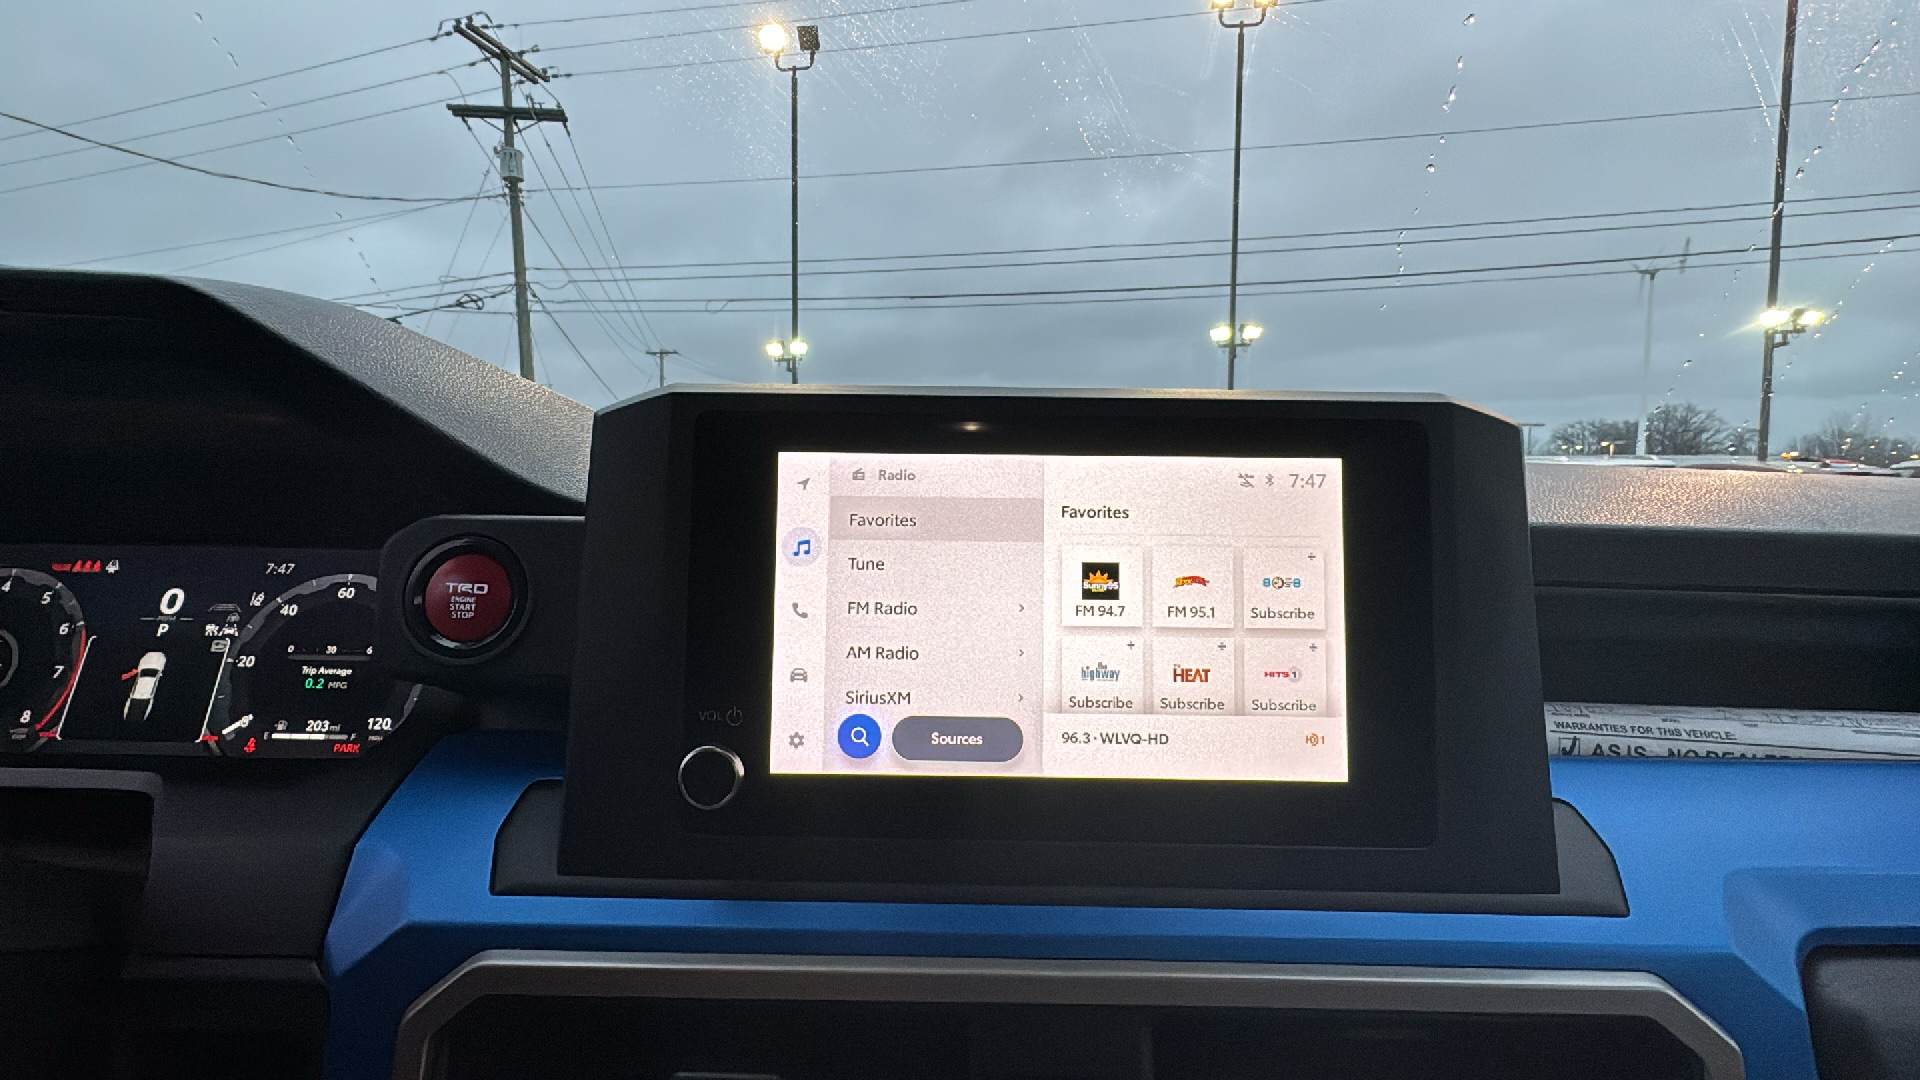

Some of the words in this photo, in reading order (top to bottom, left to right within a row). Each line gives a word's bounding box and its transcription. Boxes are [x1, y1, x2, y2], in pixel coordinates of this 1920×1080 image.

[878, 470, 916, 482] Radio
[1289, 474, 1326, 489] 7:47
[1061, 505, 1129, 520] Favorites
[849, 513, 917, 528] Favorites
[265, 562, 295, 575] 7:47
[848, 557, 885, 571] Tune
[338, 587, 355, 600] 60
[445, 582, 489, 595] TRD
[41, 592, 52, 604] 5
[159, 587, 185, 615] 0
[280, 603, 298, 617] 40
[449, 603, 477, 611] START
[848, 602, 870, 615] FM
[874, 601, 918, 616] Radio
[1075, 606, 1095, 617] FM
[1098, 605, 1126, 617] 94.7
[1167, 606, 1187, 618] FM
[1190, 606, 1216, 618] 95.1
[1250, 607, 1316, 620] Subscribe
[451, 611, 475, 619] STOP
[59, 623, 71, 635] 6
[156, 623, 170, 637] P
[846, 647, 871, 660] AM
[875, 646, 919, 661] Radio
[237, 655, 255, 667] 20
[53, 665, 64, 678] 7
[301, 665, 317, 676] Trip
[318, 665, 353, 677] Average
[1081, 665, 1120, 681] highway
[1173, 668, 1211, 683] HEAT
[305, 677, 325, 690] 0.2
[327, 681, 348, 690] MPG
[845, 691, 911, 705] SiriusXM
[1069, 696, 1133, 709] Subscribe
[1160, 697, 1225, 710] Subscribe
[1251, 699, 1317, 712] Subscribe
[20, 710, 31, 723] 8
[305, 719, 330, 732] 203
[367, 717, 391, 731] 120
[1553, 720, 1627, 734] WARRANTIES
[1630, 725, 1653, 735] FOR
[1656, 727, 1682, 737] THIS
[931, 732, 983, 745] Sources
[1061, 732, 1091, 745] 96.3
[1100, 732, 1169, 746] WLVQ-HD
[333, 743, 361, 753] PARK
[1591, 743, 1621, 757] AS
